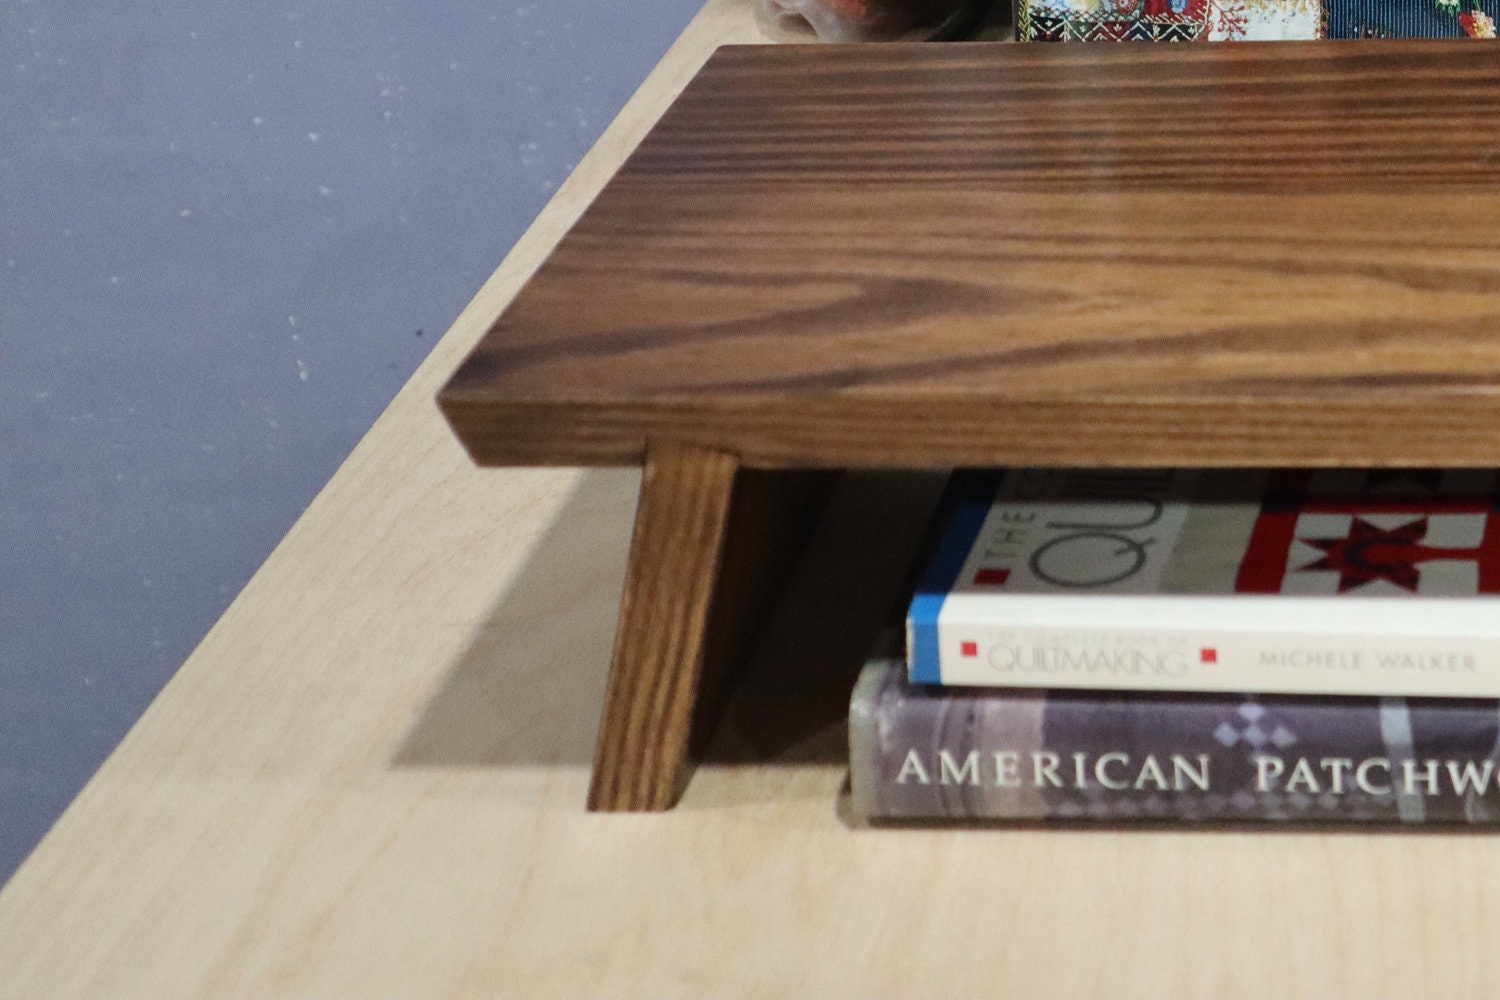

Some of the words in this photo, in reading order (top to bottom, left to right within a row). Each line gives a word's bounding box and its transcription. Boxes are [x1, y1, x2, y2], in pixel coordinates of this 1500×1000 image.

[985, 512, 1037, 560] THE
[987, 643, 1189, 678] QUILTMAKING
[1259, 651, 1362, 670] MICHELE
[1376, 652, 1477, 673] WALKER
[895, 749, 1211, 793] AMERICAN
